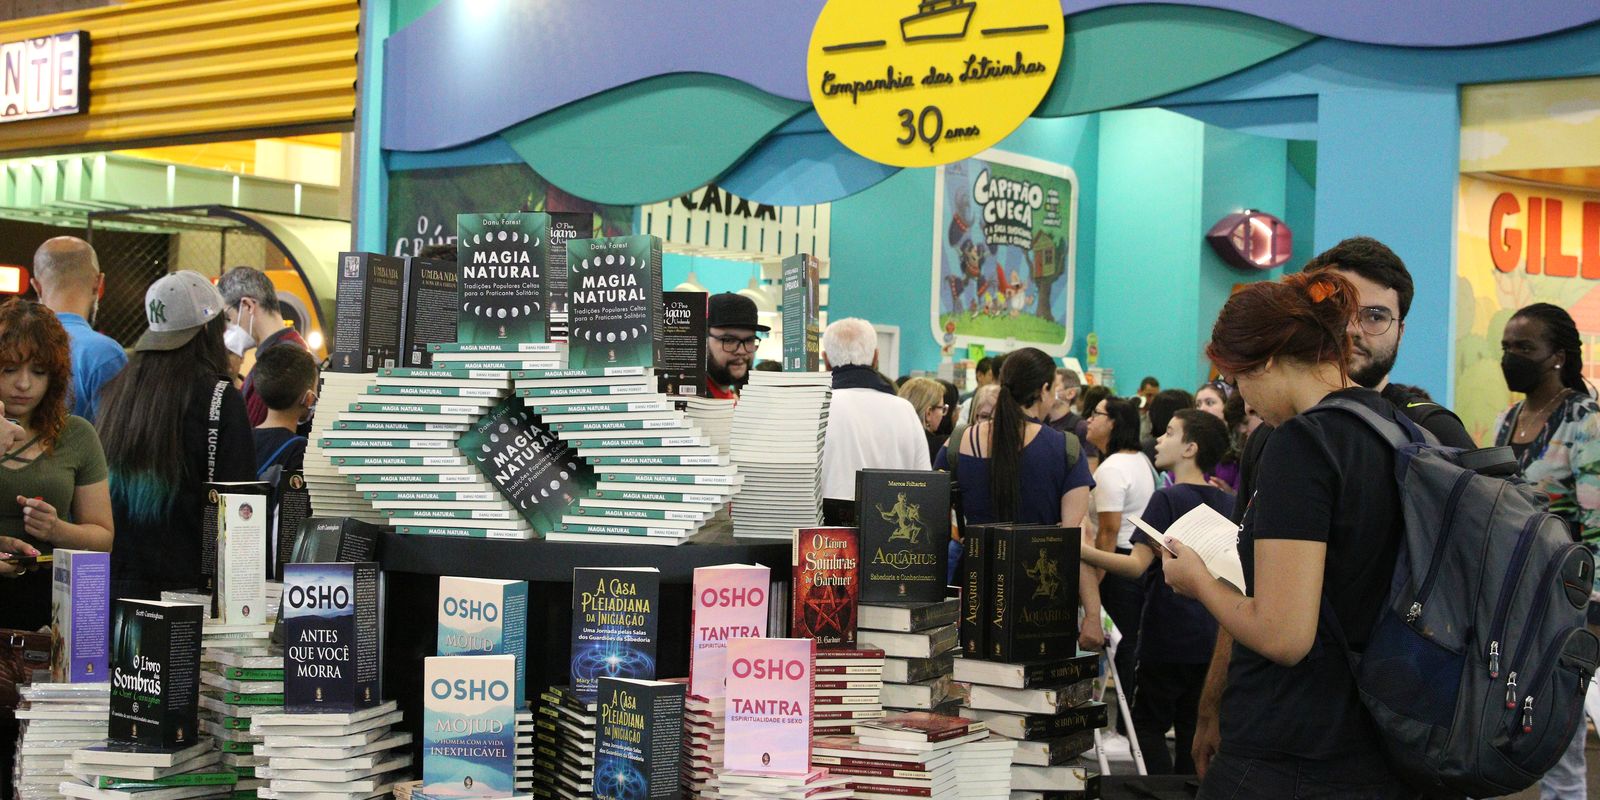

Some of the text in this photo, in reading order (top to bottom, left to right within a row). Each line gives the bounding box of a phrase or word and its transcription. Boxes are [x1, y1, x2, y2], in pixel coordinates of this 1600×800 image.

[821, 51, 1046, 104] Companhia das Letrinhas
[897, 105, 980, 146] 30 anos
[984, 200, 1032, 227] CUECA
[418, 216, 428, 235] O
[550, 227, 577, 245] igano
[473, 250, 530, 264] MAGIA
[421, 268, 458, 282] UMBANDA
[463, 266, 540, 279] NATURAL
[582, 273, 637, 289] MAGIA
[464, 282, 540, 291] Tradições Populares Celtas
[573, 288, 646, 304] NATURAL
[595, 313, 622, 321] Praticante
[624, 311, 646, 319] Solitário
[601, 306, 629, 315] Populares
[663, 306, 691, 325] igano
[478, 419, 495, 434] Danu
[493, 424, 543, 469] MAGIA
[495, 430, 560, 486] NATURAL
[506, 452, 552, 493] Tradições Populares
[512, 485, 525, 498] para
[528, 461, 552, 483] Praticante
[812, 533, 848, 550] O Livro
[802, 550, 857, 574] Sombras
[871, 547, 937, 567] AQUARIUS
[805, 571, 852, 588] de Gardner
[870, 573, 896, 581] Sabedoria
[288, 585, 349, 610] OSHO
[593, 578, 636, 598] A CASA
[700, 587, 764, 608] OSHO
[581, 592, 651, 613] PLEIADIANA
[966, 571, 980, 626] AQUARIUS
[993, 574, 1006, 629] AQUARIUS
[443, 596, 498, 623] OSHO
[586, 611, 645, 627] DA INICIAÇÃO
[299, 629, 338, 643] ANTES
[445, 633, 496, 653] MOJUD
[700, 625, 761, 642] TANTRA
[823, 635, 841, 644] Gardner
[288, 644, 350, 663] QUE VOCÊ
[133, 654, 161, 673] O Livro
[297, 664, 342, 679] MORRA
[732, 657, 805, 681] OSHO
[113, 666, 162, 696] Sombras
[431, 678, 509, 702] OSHO
[610, 689, 637, 711] A CASA
[732, 698, 803, 716] TANTRA
[601, 703, 645, 731] PLEIADIANA
[731, 716, 781, 724] ESPIRITUALIDADE
[434, 718, 504, 736] MOJUD
[604, 725, 641, 744] DA INICIAÇÃO
[431, 745, 507, 758] INEXPLICÁVEL
